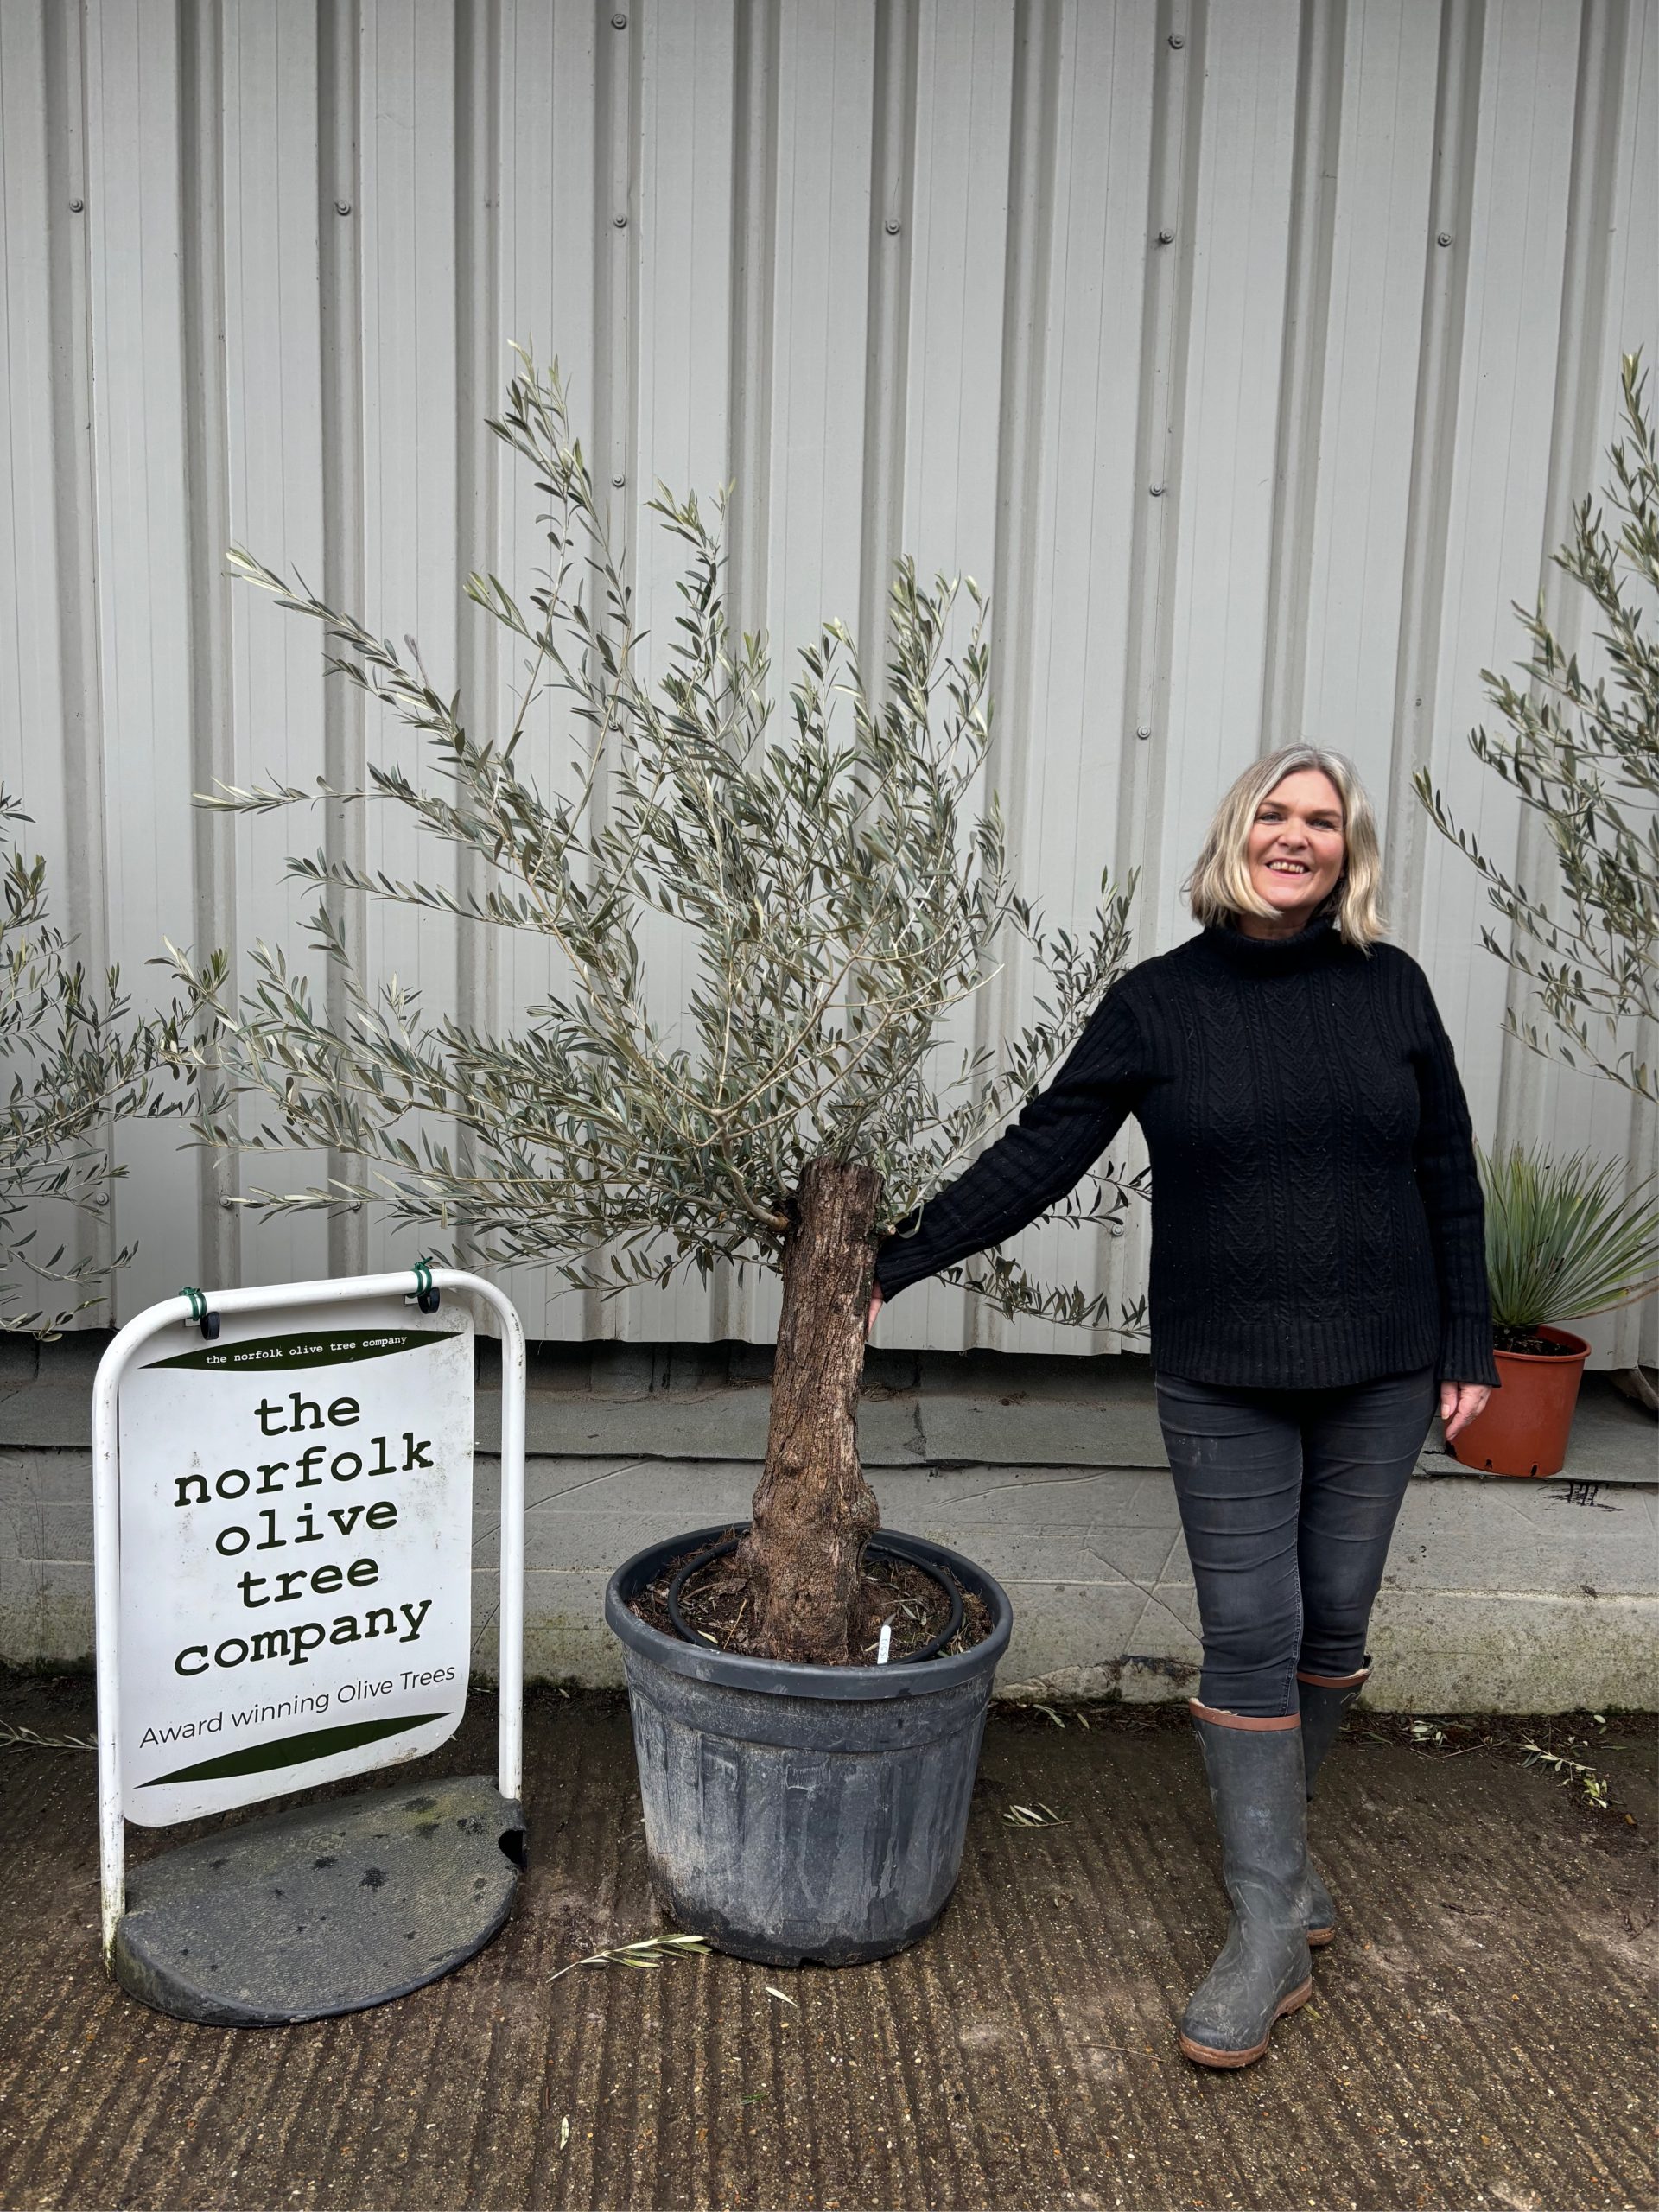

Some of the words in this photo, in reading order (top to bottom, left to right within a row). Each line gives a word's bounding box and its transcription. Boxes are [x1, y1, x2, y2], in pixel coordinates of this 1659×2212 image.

[206, 1355, 227, 1365] the
[233, 1348, 283, 1362] norfolk
[289, 1344, 323, 1357] olive
[330, 1342, 356, 1352] tree
[362, 1335, 408, 1349] company
[254, 1392, 360, 1437] the
[174, 1433, 435, 1508] norfolk
[214, 1501, 397, 1556] olive
[236, 1558, 379, 1609] tree
[174, 1599, 433, 1676] company
[139, 1711, 223, 1749] Award
[231, 1693, 329, 1727] winning
[337, 1680, 393, 1704] Olive
[400, 1666, 455, 1690] Trees
